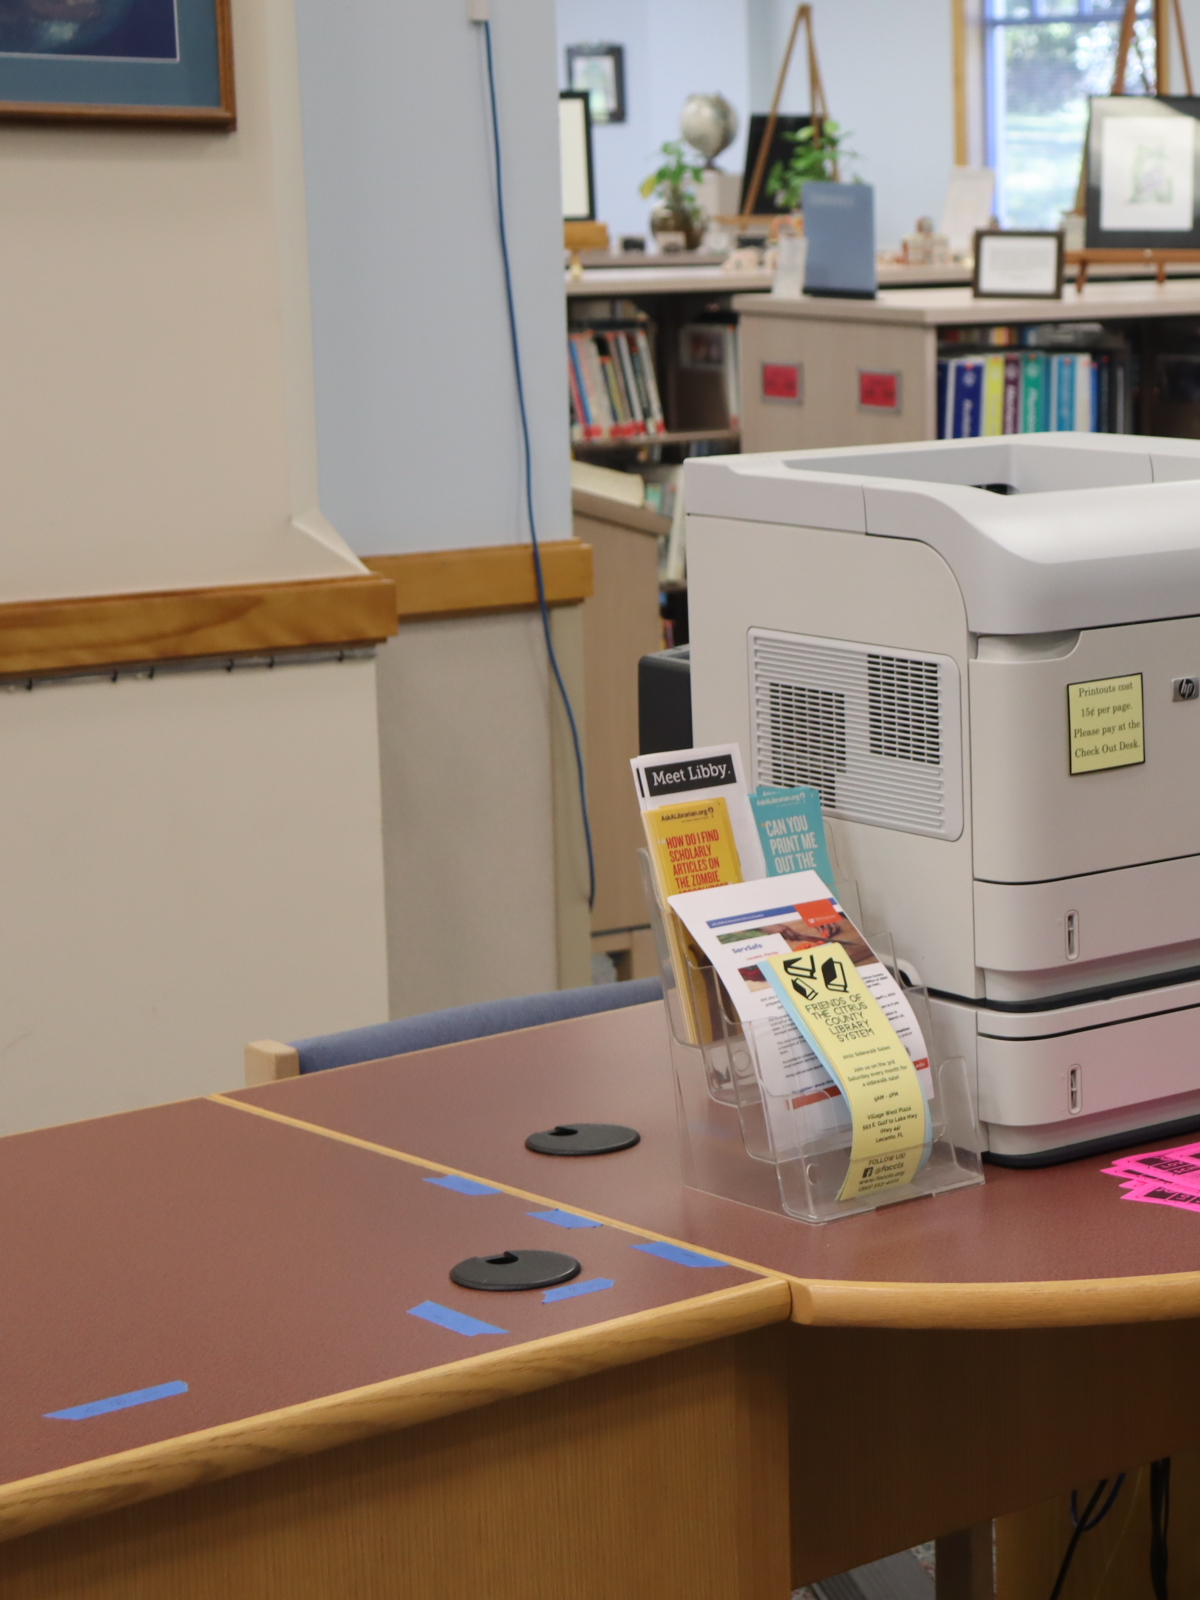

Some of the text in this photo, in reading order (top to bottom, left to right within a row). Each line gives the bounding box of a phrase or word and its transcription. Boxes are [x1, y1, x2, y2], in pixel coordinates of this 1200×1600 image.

[1078, 682, 1133, 698] Printouts cost
[1081, 703, 1133, 718] 15¢ per page.
[1073, 720, 1140, 738] Please pay at the
[1075, 739, 1140, 758] Check Out Desk.
[652, 762, 731, 786] Meet Libby.
[765, 815, 808, 837] CAN YOU
[666, 829, 719, 849] HOW DO I FIND
[770, 832, 818, 856] PRINT ME
[669, 845, 712, 862] SCHOLARLY
[672, 857, 720, 876] ARTICLES ON
[775, 851, 817, 874] OUT THE
[675, 877, 691, 889] THE
[691, 870, 720, 887] ZOMBIE
[732, 943, 763, 954] ServSafe
[804, 993, 862, 1013] FRIENDS OF
[811, 1001, 868, 1021] THE CITRUS
[825, 1011, 864, 1027] COUNTY
[829, 1019, 870, 1036] LIBRARY
[836, 1028, 875, 1043] SYSTEM
[854, 1048, 877, 1057] Sidewalk
[848, 1073, 870, 1082] Saturday
[866, 1078, 887, 1086] sidewalk
[867, 1112, 884, 1120] Village
[885, 1108, 898, 1116] West
[868, 1152, 906, 1166] FOLLOW US!
